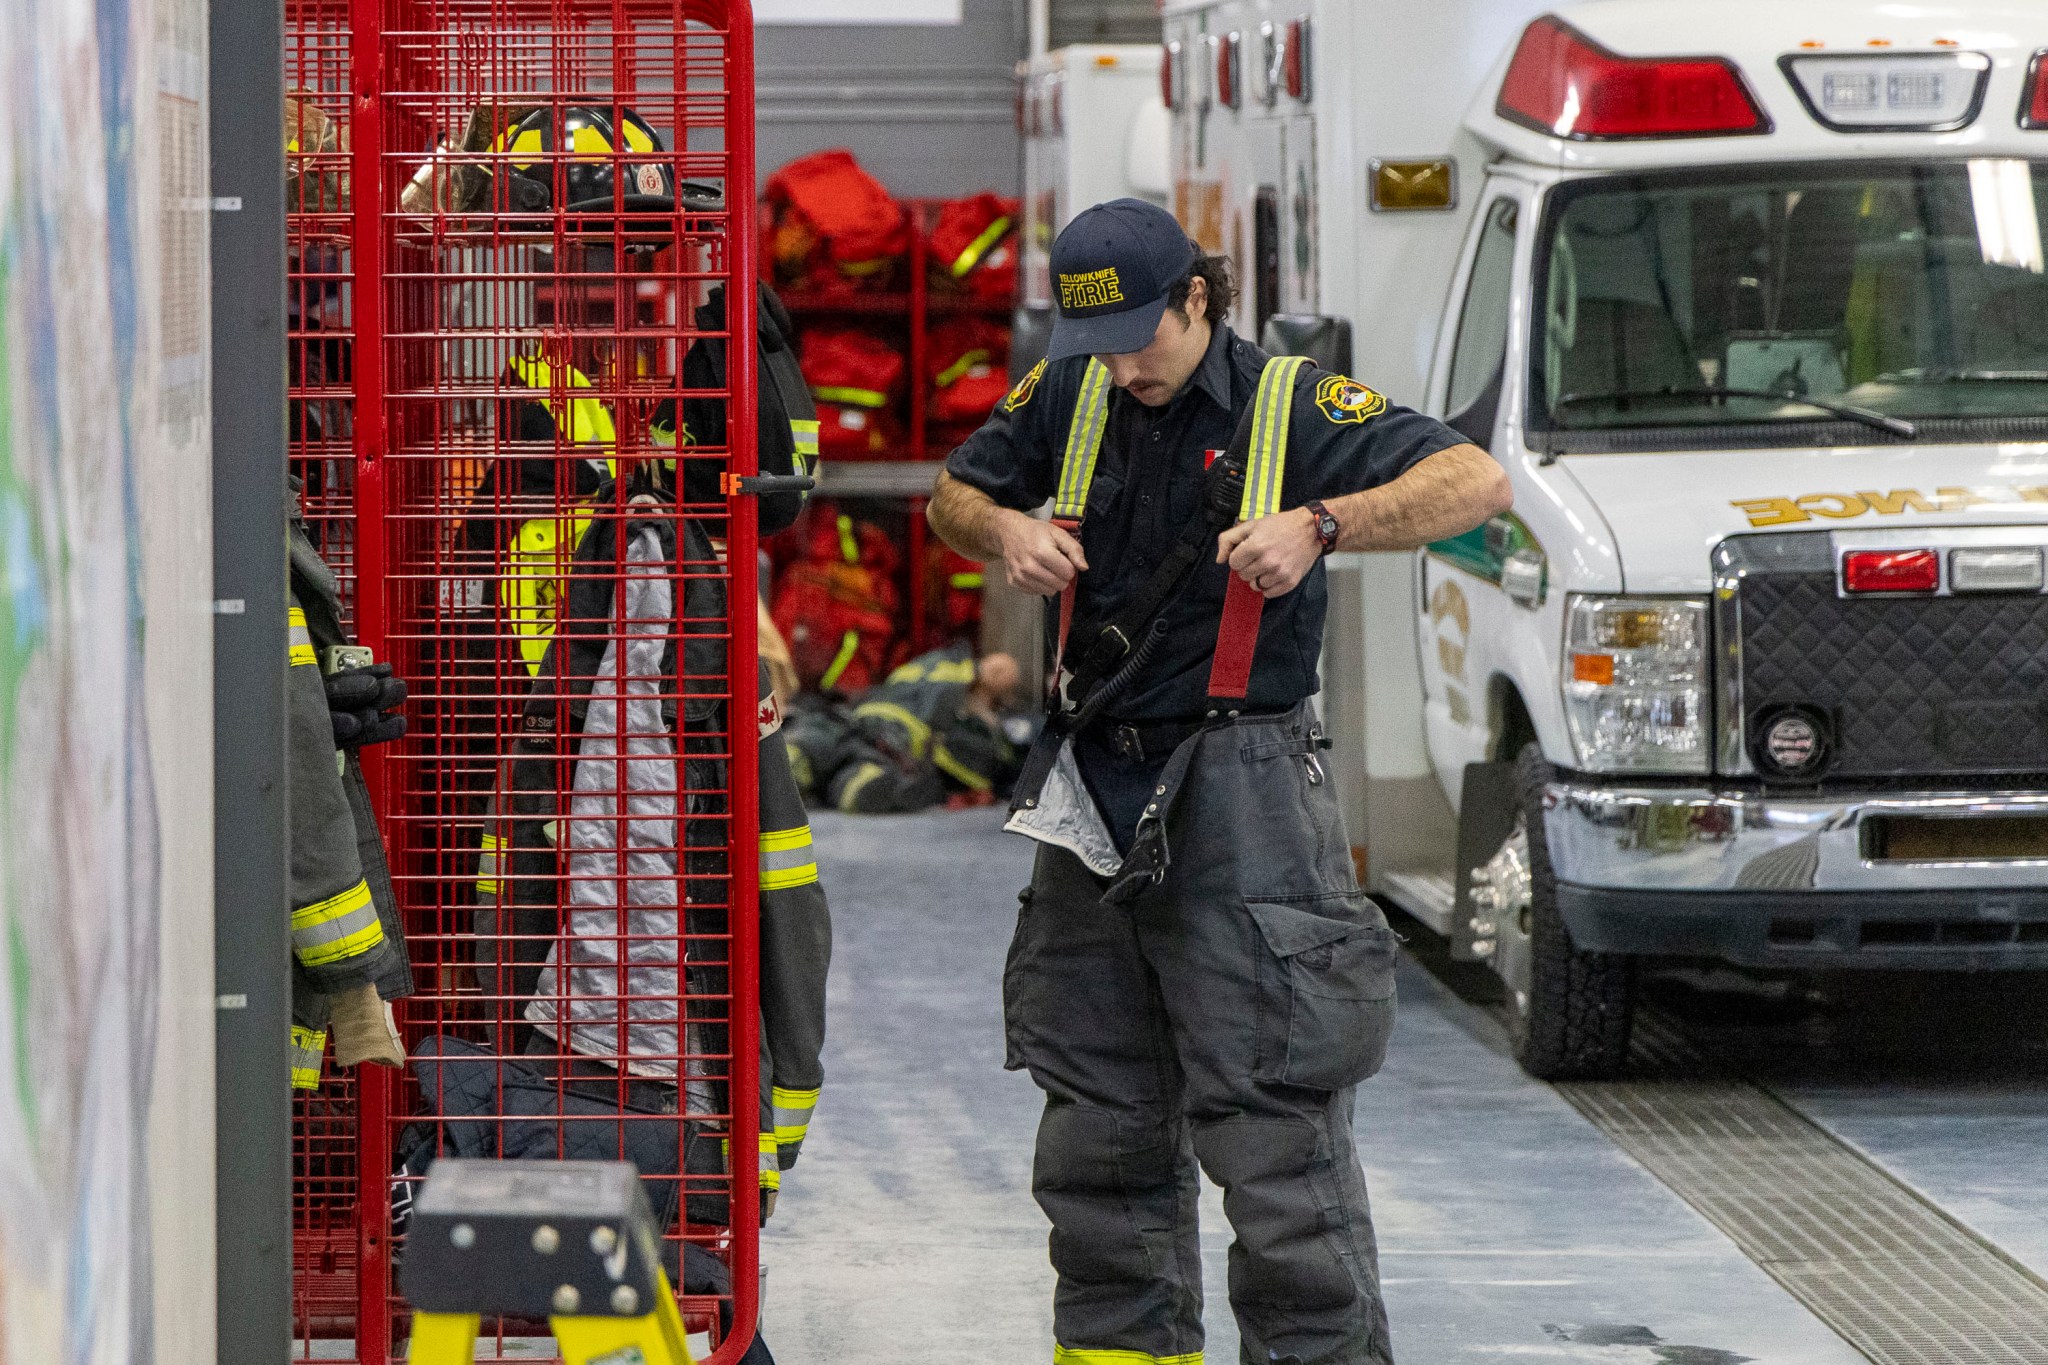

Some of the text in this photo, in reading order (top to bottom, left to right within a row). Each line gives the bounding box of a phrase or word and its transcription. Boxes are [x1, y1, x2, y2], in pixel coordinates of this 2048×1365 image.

[1059, 267, 1117, 283] YELLOWKNIFE
[1060, 276, 1124, 308] FIRE
[538, 716, 556, 727] Star
